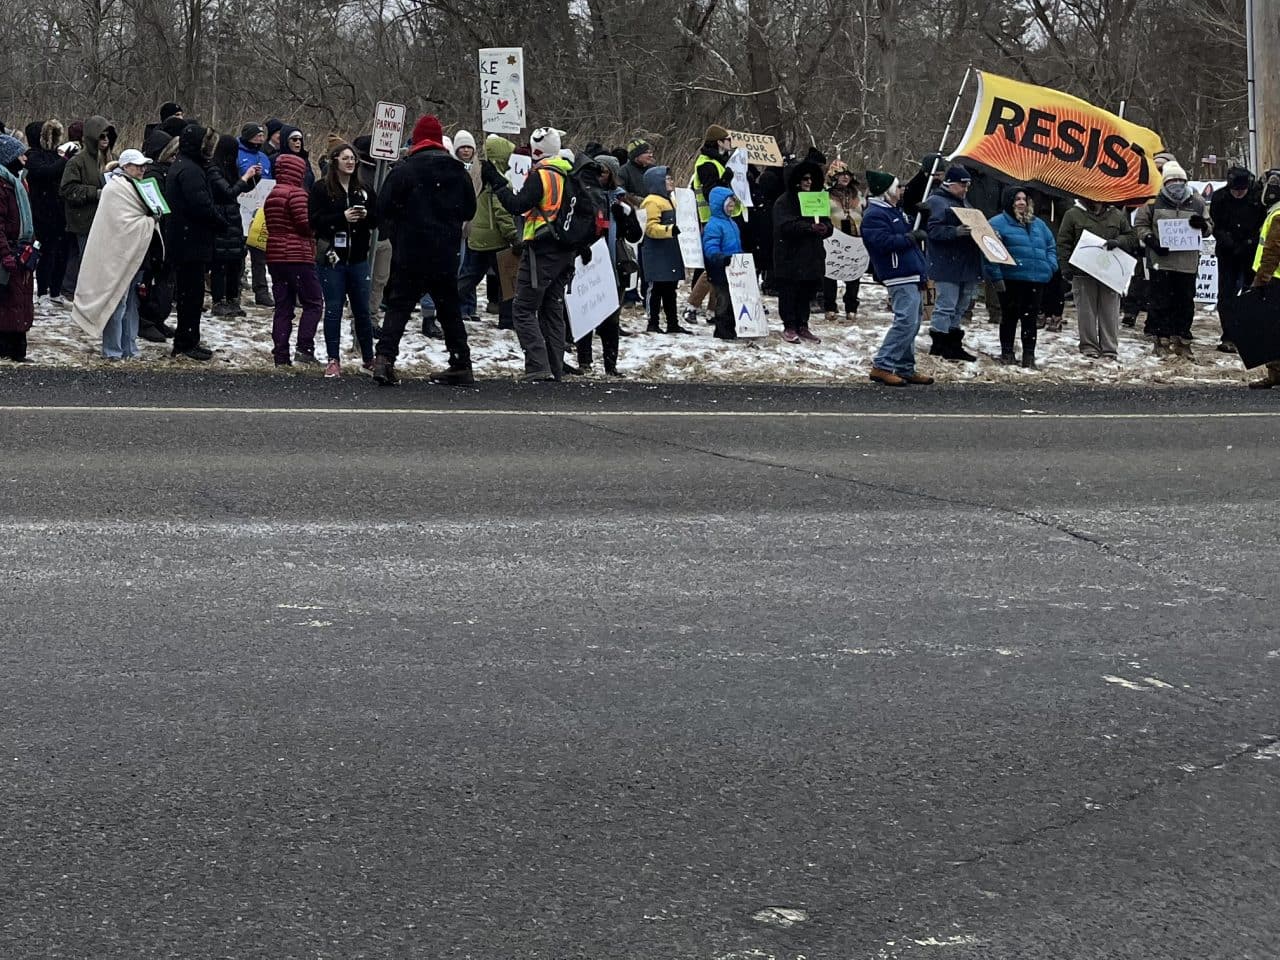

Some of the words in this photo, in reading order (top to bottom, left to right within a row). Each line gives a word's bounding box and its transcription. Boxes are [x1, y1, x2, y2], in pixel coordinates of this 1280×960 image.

[384, 107, 396, 119] NO
[376, 119, 401, 132] PARKING
[379, 139, 393, 148] TIME
[731, 132, 774, 144] PROTECT
[984, 96, 1150, 185] RESIST
[745, 143, 767, 153] OUR
[746, 152, 777, 163] ARKS
[1161, 235, 1193, 247] GREAT
